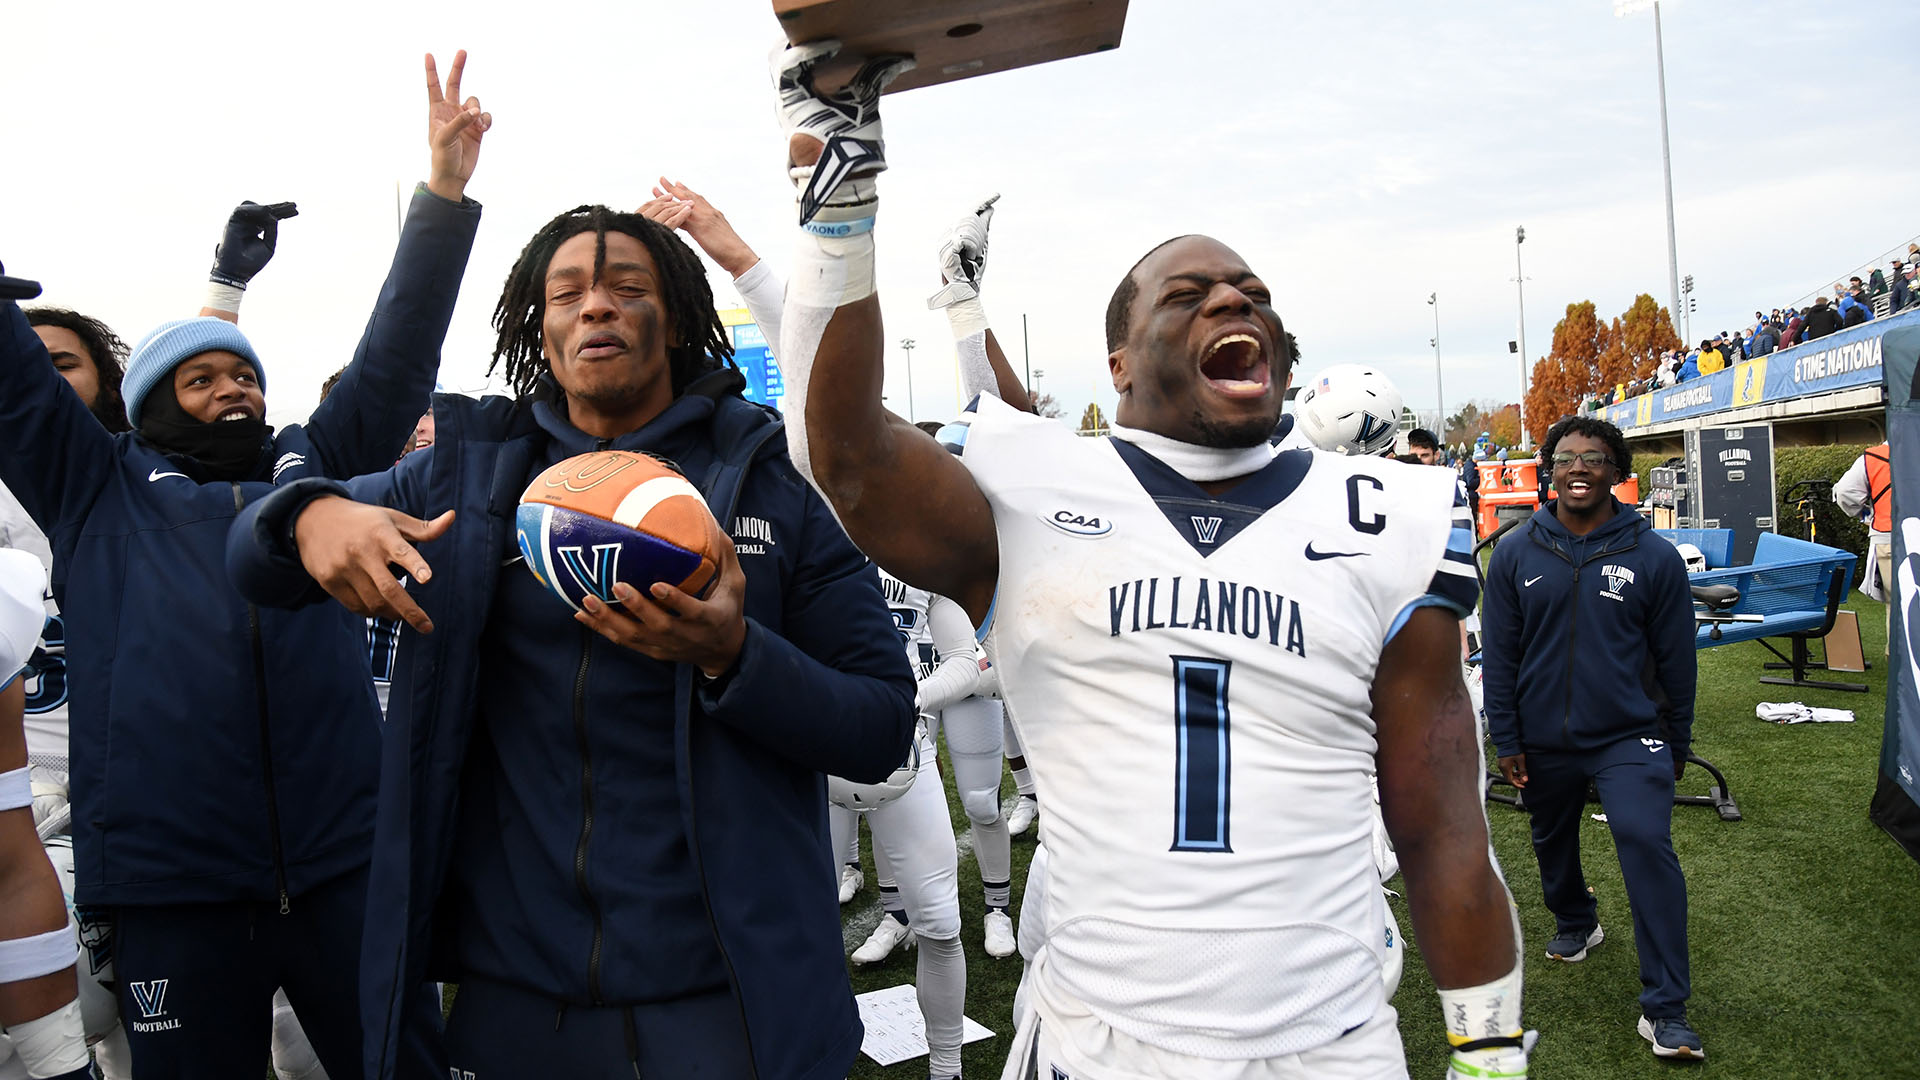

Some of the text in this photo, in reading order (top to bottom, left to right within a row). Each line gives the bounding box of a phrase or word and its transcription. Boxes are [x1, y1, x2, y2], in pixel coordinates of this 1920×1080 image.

[1794, 335, 1882, 384] 6 TIME NATIONA
[1718, 448, 1752, 463] VILLANOVA
[1346, 474, 1387, 535] C
[731, 516, 776, 545] ANOVA
[1053, 510, 1101, 530] CAA
[1190, 516, 1223, 543] V
[1600, 564, 1635, 585] VILLANOVA
[1607, 575, 1627, 594] V
[1599, 590, 1624, 602] FOOTBALL
[1109, 576, 1307, 658] VILLANOVA
[1168, 654, 1235, 854] 1
[130, 978, 169, 1018] V
[133, 1018, 182, 1033] FOOTBALL
